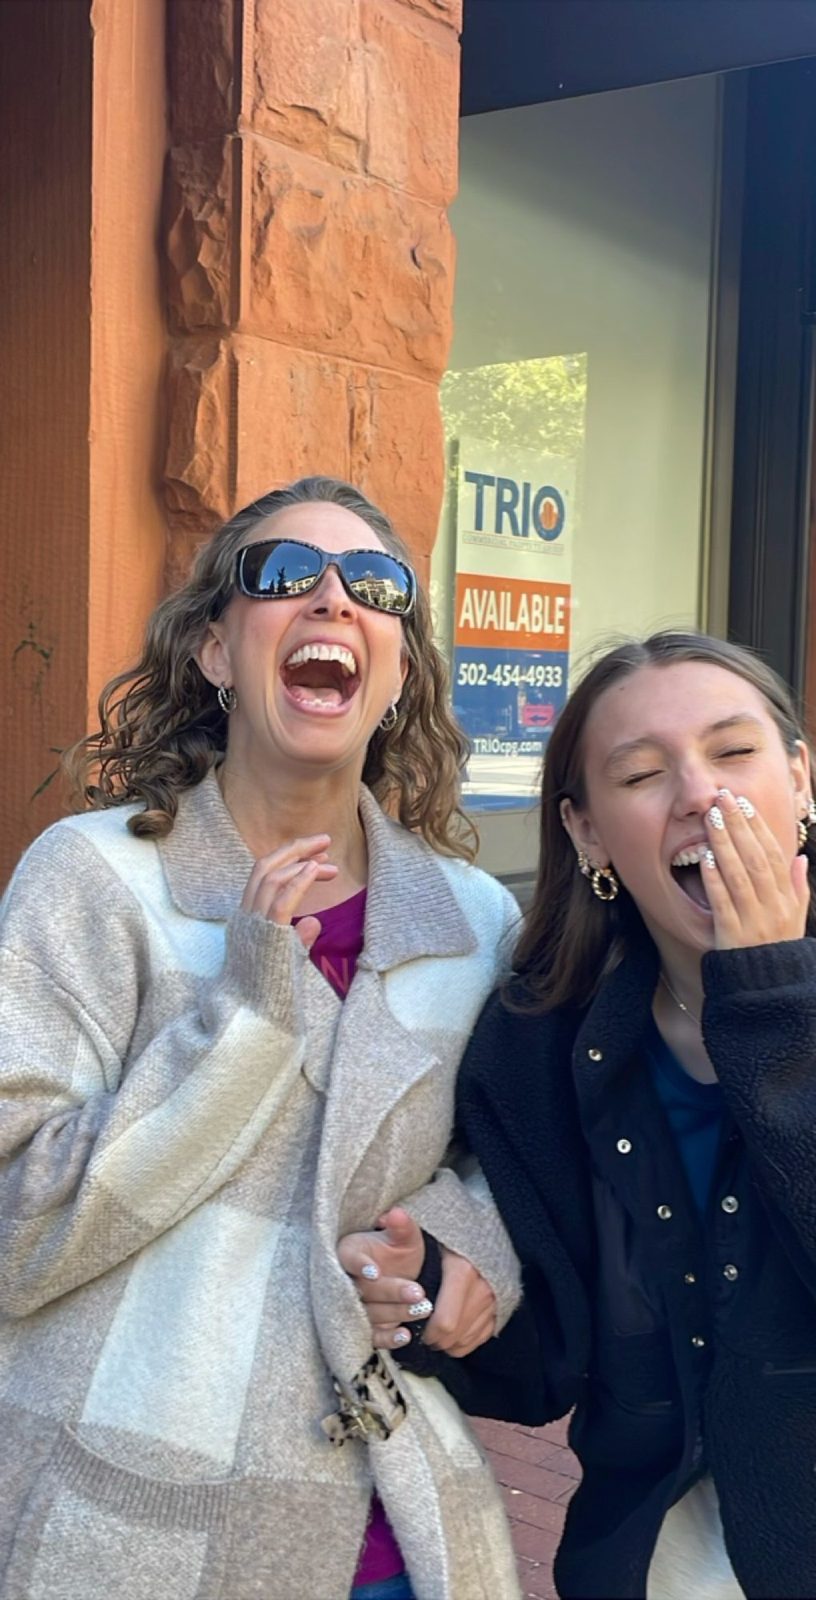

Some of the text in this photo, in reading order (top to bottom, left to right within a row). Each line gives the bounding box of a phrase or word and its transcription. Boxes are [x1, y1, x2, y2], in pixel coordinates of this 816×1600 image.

[464, 471, 565, 542] TRIO
[458, 588, 565, 635] AVAILABLE
[457, 663, 563, 688] 502-454-4933
[473, 738, 542, 757] TRIOcpg.com
